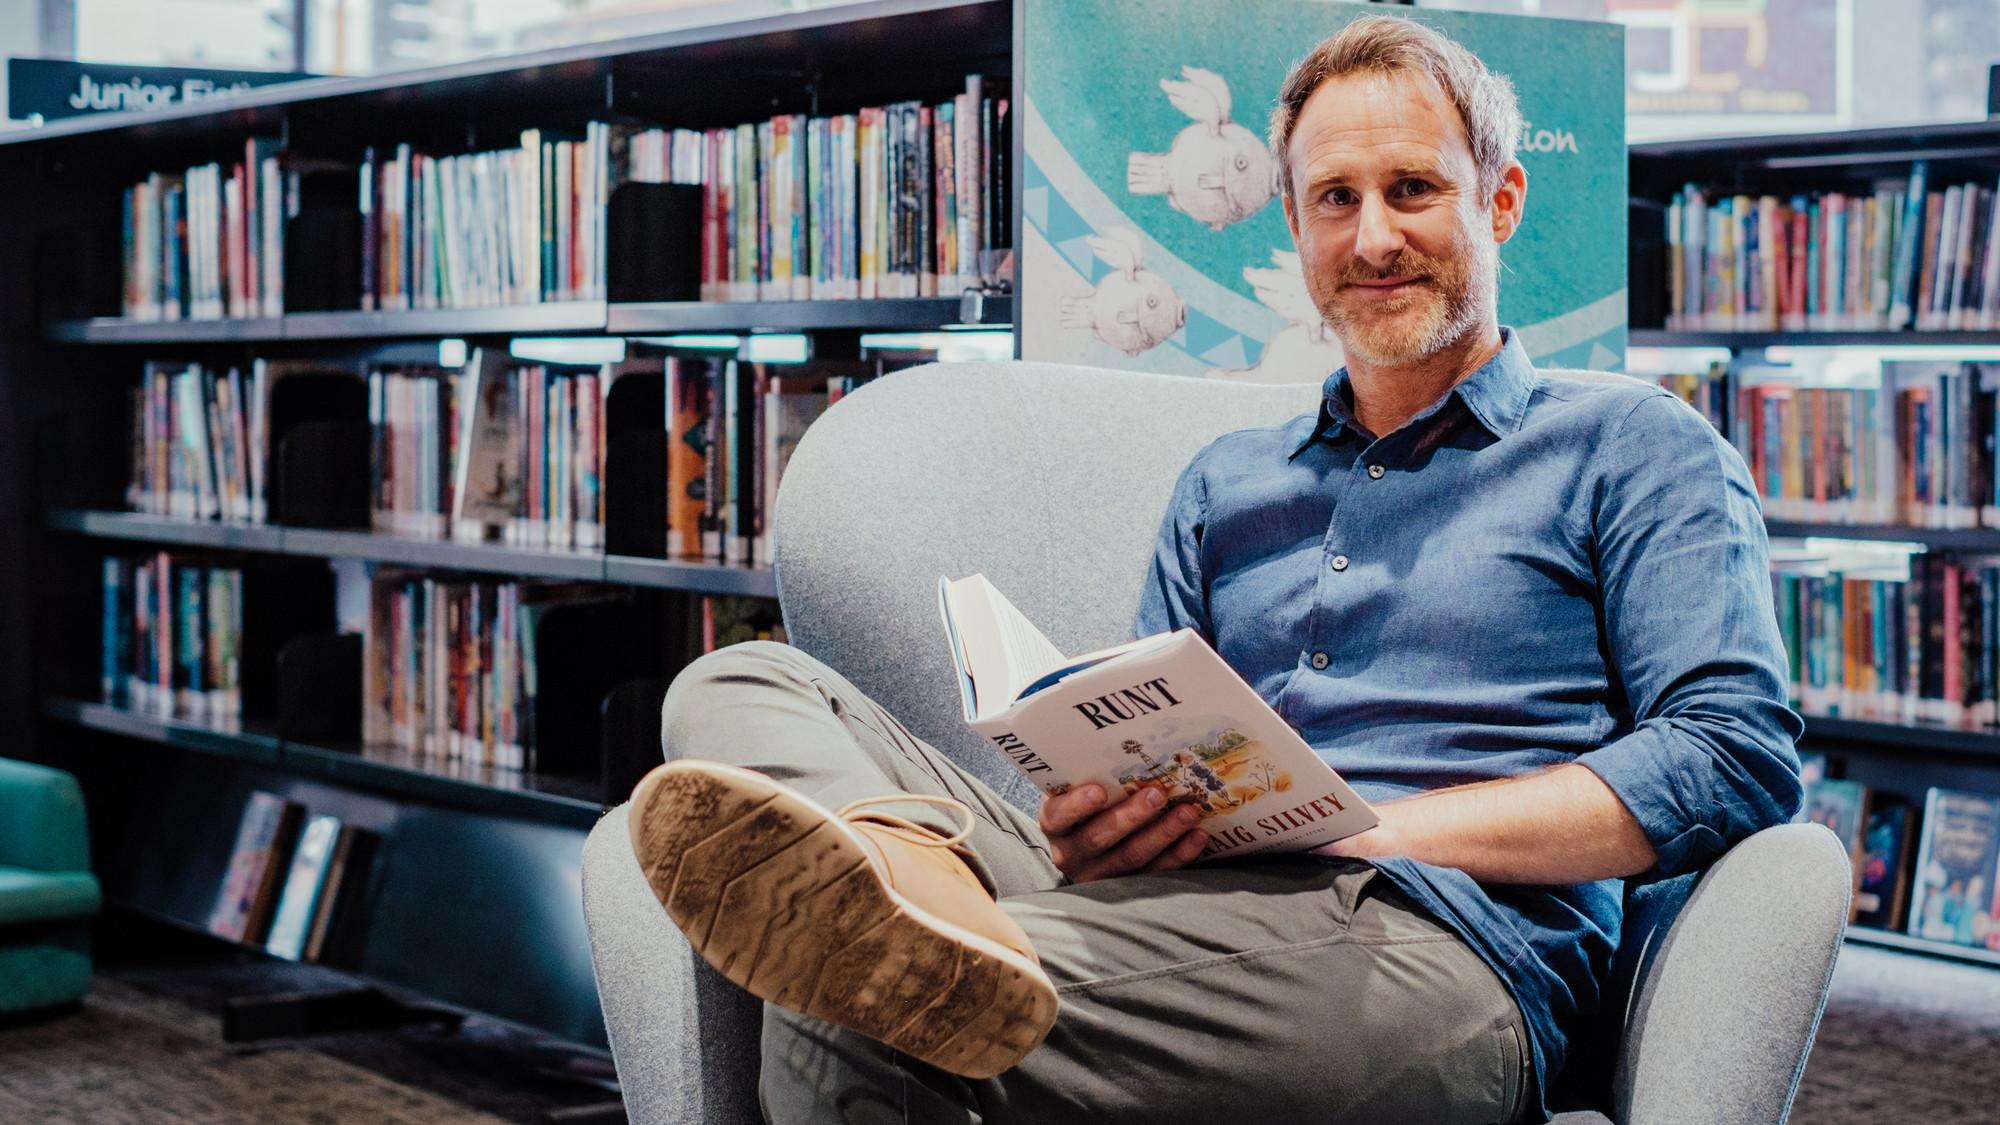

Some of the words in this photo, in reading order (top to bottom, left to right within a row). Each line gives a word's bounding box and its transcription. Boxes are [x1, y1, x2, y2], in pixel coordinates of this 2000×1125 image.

[69, 74, 176, 111] Junior
[1072, 677, 1182, 731] RUNT
[992, 732, 1052, 774] RUNT
[1256, 792, 1346, 837] SILVEY
